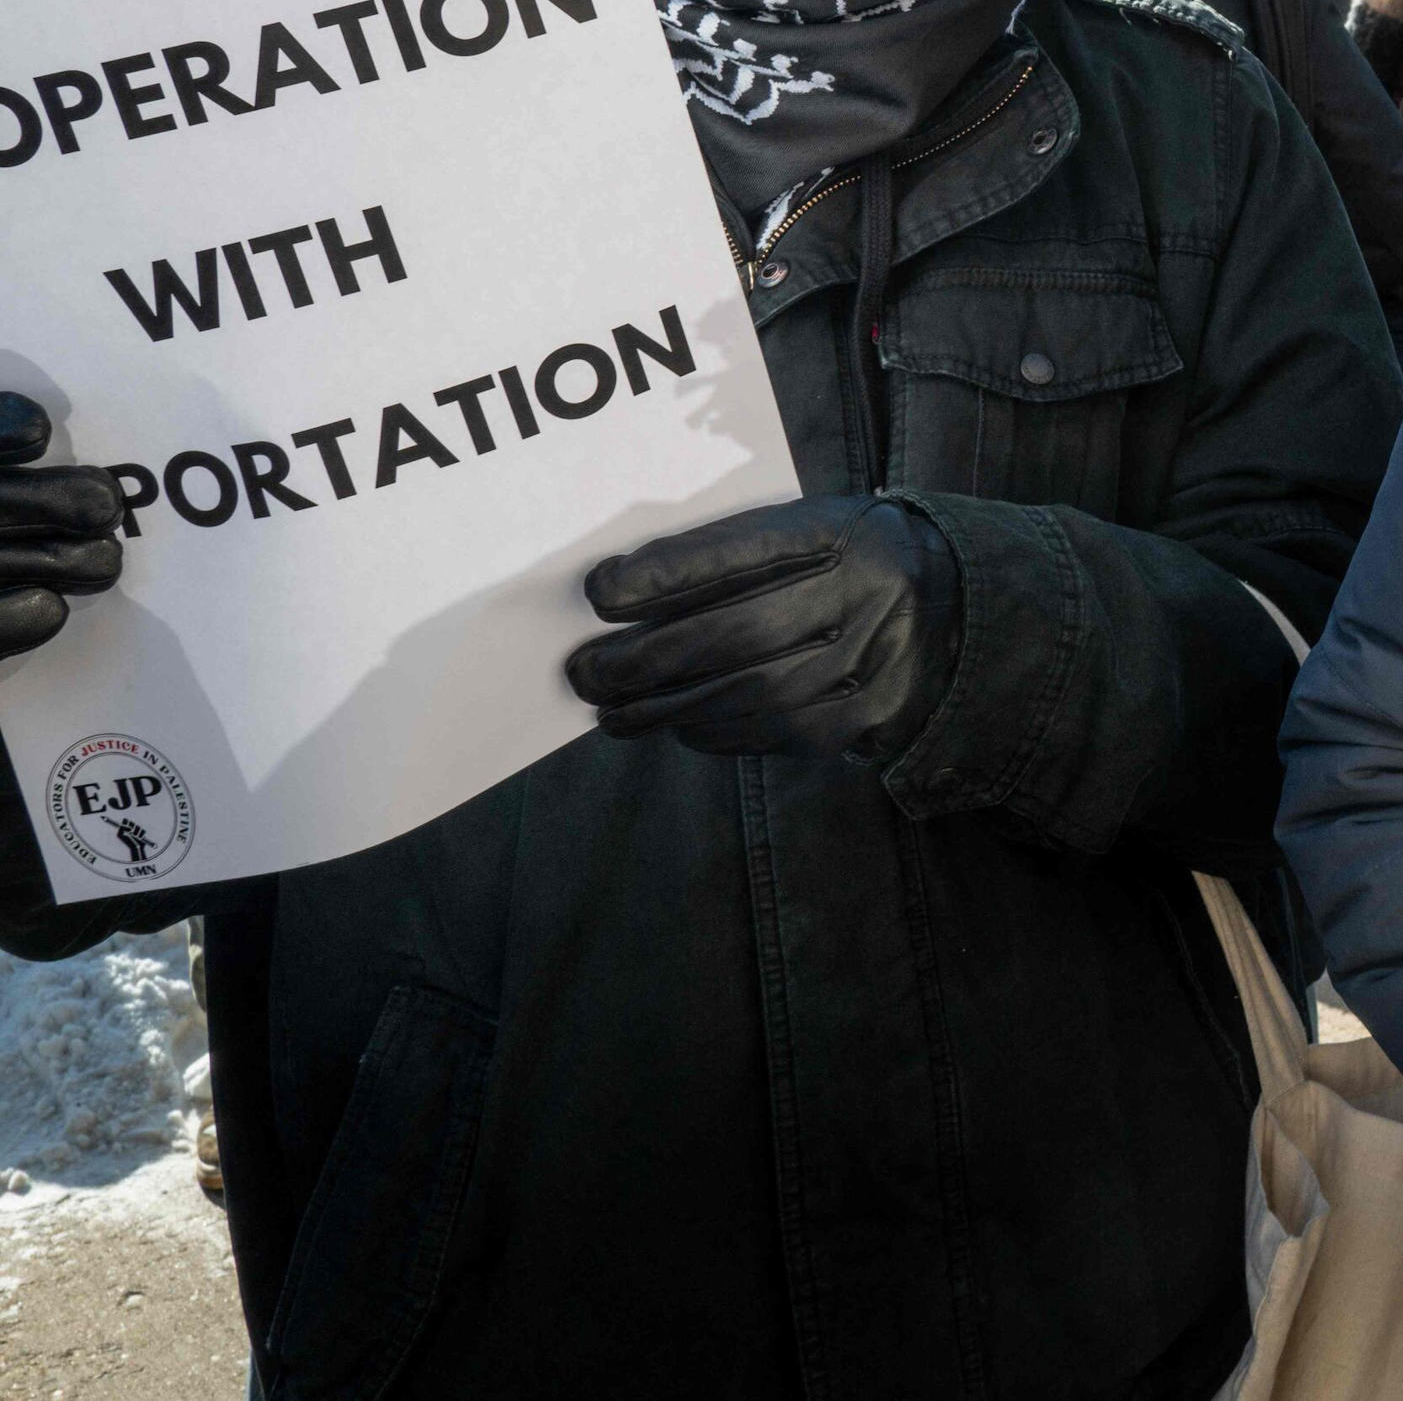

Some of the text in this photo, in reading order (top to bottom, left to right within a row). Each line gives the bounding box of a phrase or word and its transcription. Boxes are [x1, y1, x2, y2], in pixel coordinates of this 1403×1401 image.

[103, 205, 408, 342] WITH
[53, 740, 190, 865] EDUCATORS FOR JUSTICE IN PALESTINE
[72, 775, 162, 816] EJP
[125, 864, 157, 878] UMN
